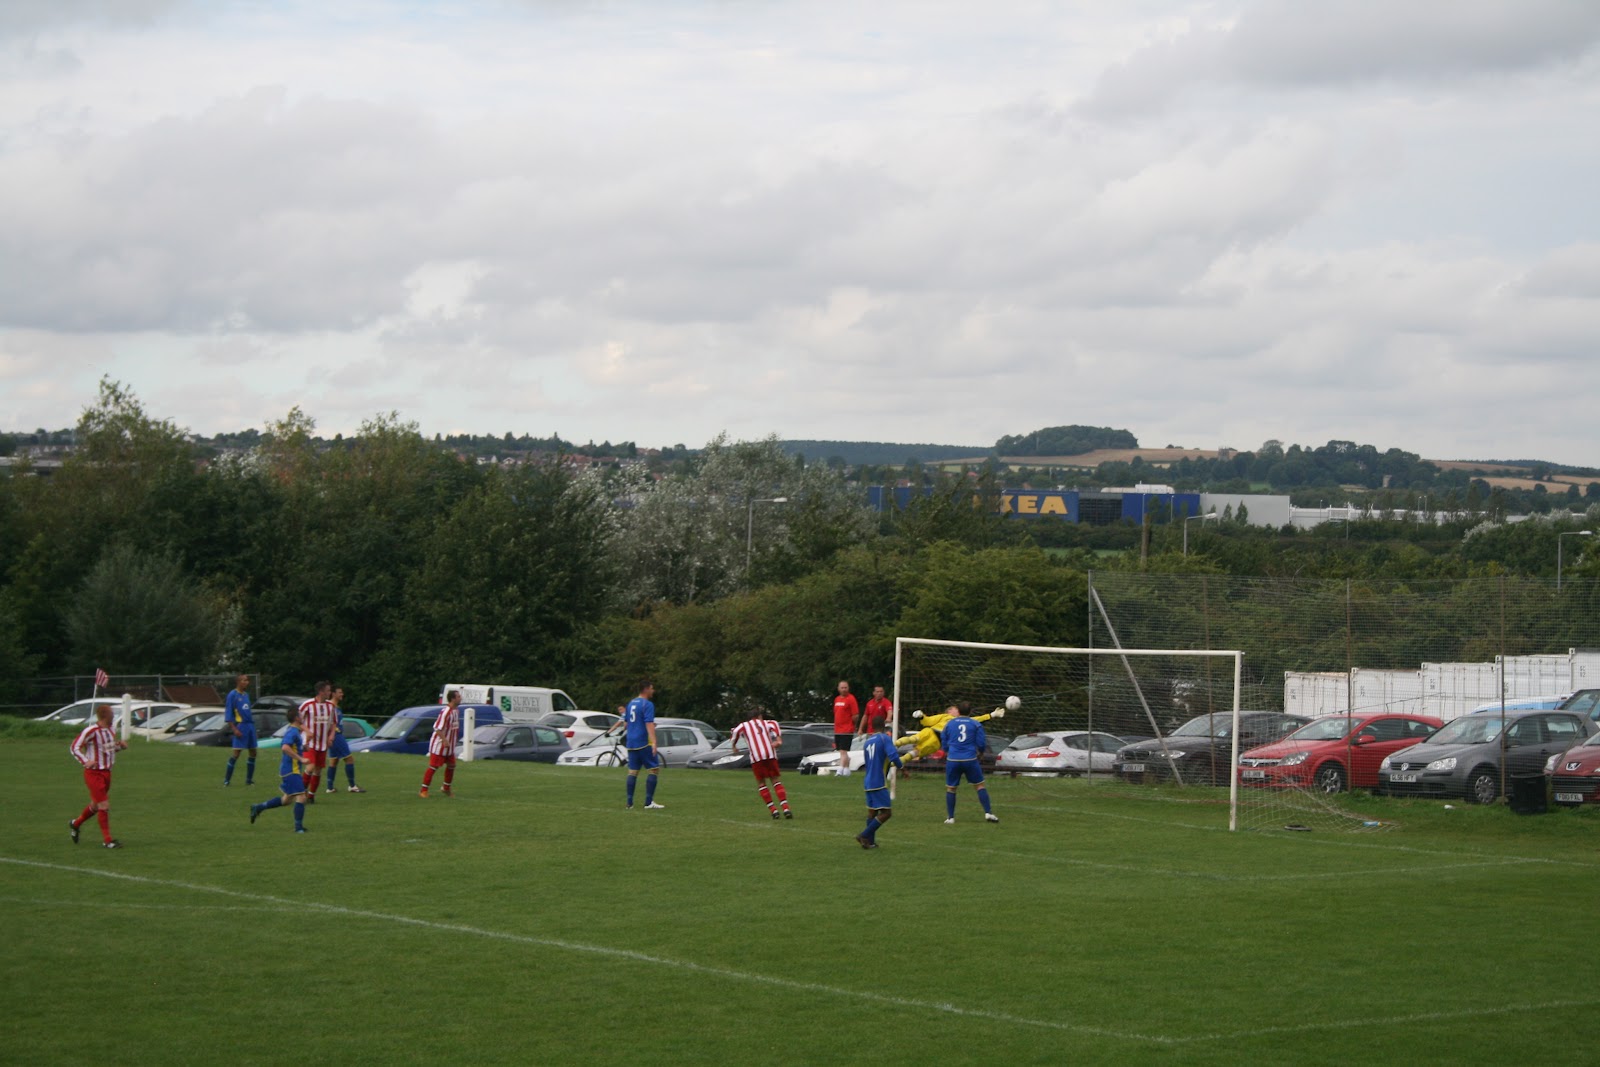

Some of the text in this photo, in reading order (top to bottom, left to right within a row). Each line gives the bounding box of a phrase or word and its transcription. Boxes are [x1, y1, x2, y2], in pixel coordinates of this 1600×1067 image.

[513, 696, 540, 706] SURVEY
[630, 705, 637, 722] 5
[957, 724, 967, 743] 3
[866, 742, 876, 760] 11
